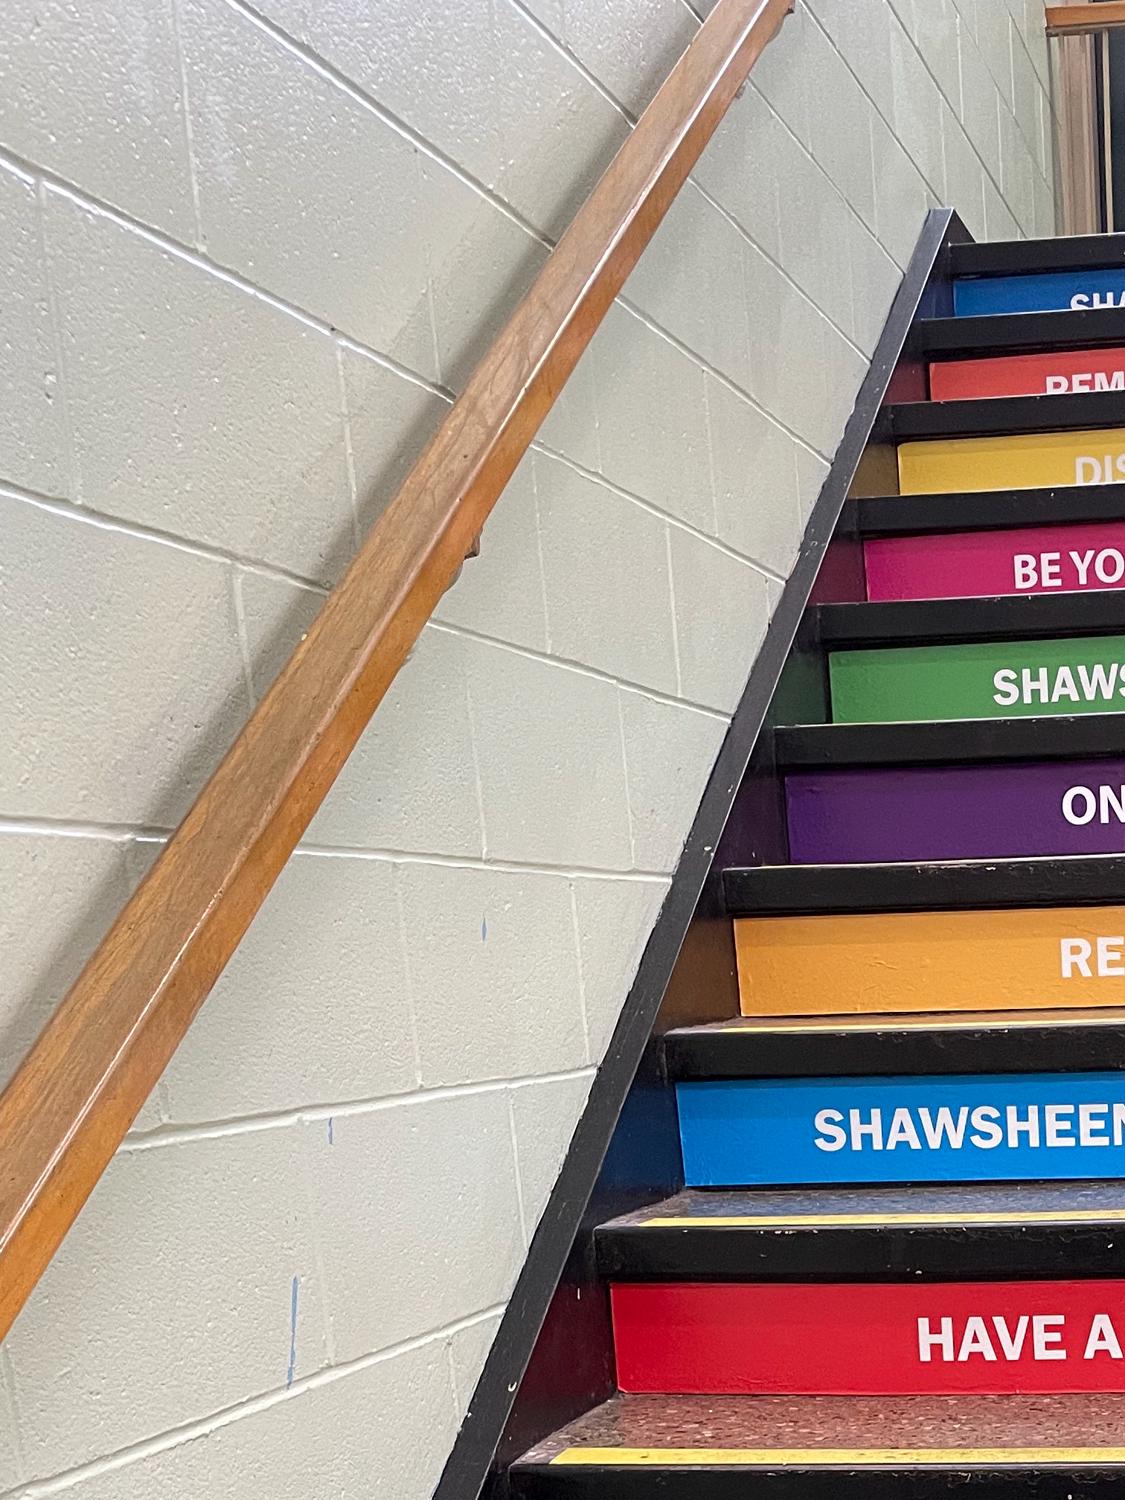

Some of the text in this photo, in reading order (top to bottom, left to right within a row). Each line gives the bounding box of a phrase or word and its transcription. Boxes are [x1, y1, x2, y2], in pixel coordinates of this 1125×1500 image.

[1014, 552, 1062, 589] BE
[918, 1315, 1066, 1361] HAVE
[1084, 1315, 1122, 1359] A
